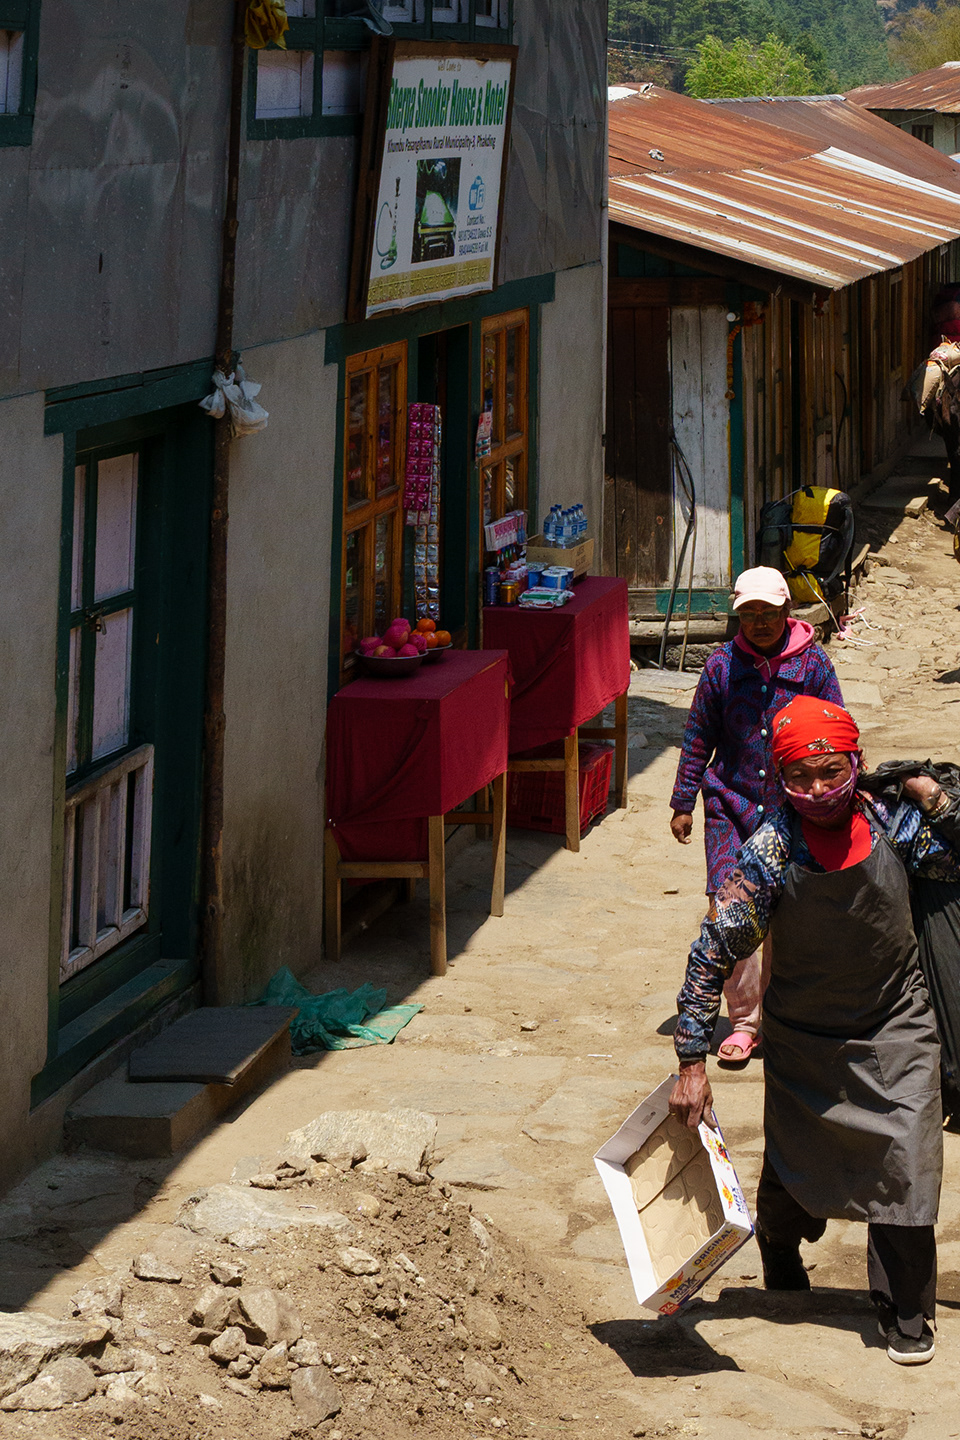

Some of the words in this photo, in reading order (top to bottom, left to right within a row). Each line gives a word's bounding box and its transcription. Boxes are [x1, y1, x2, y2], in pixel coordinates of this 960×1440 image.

[415, 78, 451, 128] Snooker
[449, 79, 477, 127] House
[476, 86, 483, 126] &
[483, 79, 507, 126] Hotel
[694, 1229, 733, 1266] ORIGINAL
